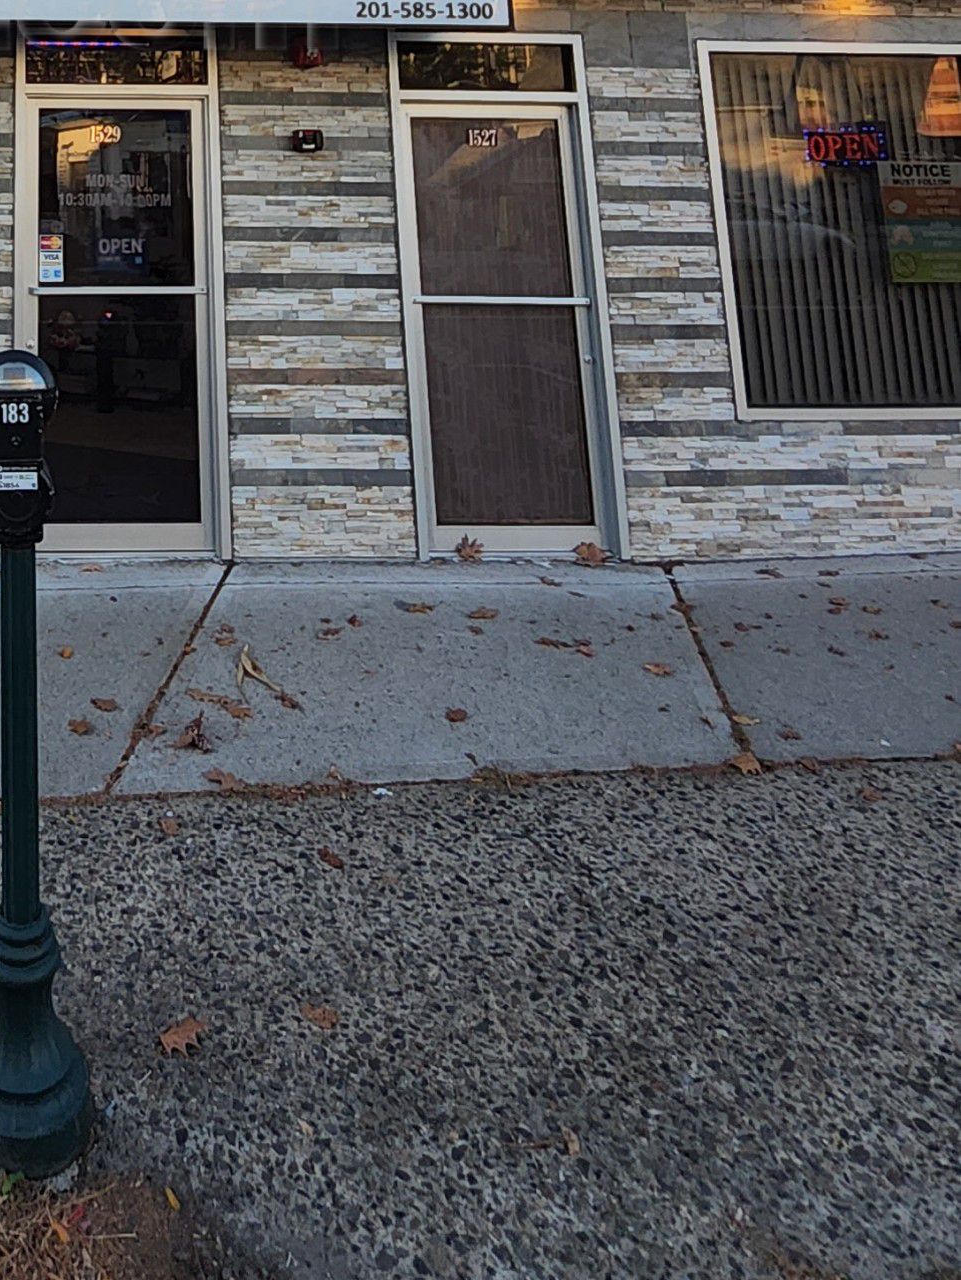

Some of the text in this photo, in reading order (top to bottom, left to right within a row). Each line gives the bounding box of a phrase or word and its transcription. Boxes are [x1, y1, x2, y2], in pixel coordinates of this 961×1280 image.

[355, 0, 494, 21] 201-585-1300
[88, 124, 121, 144] 1529
[467, 128, 498, 147] 1527
[808, 133, 879, 162] OPEN
[890, 164, 952, 178] NOTICE
[98, 238, 144, 254] OPEN
[0, 402, 30, 424] 183
